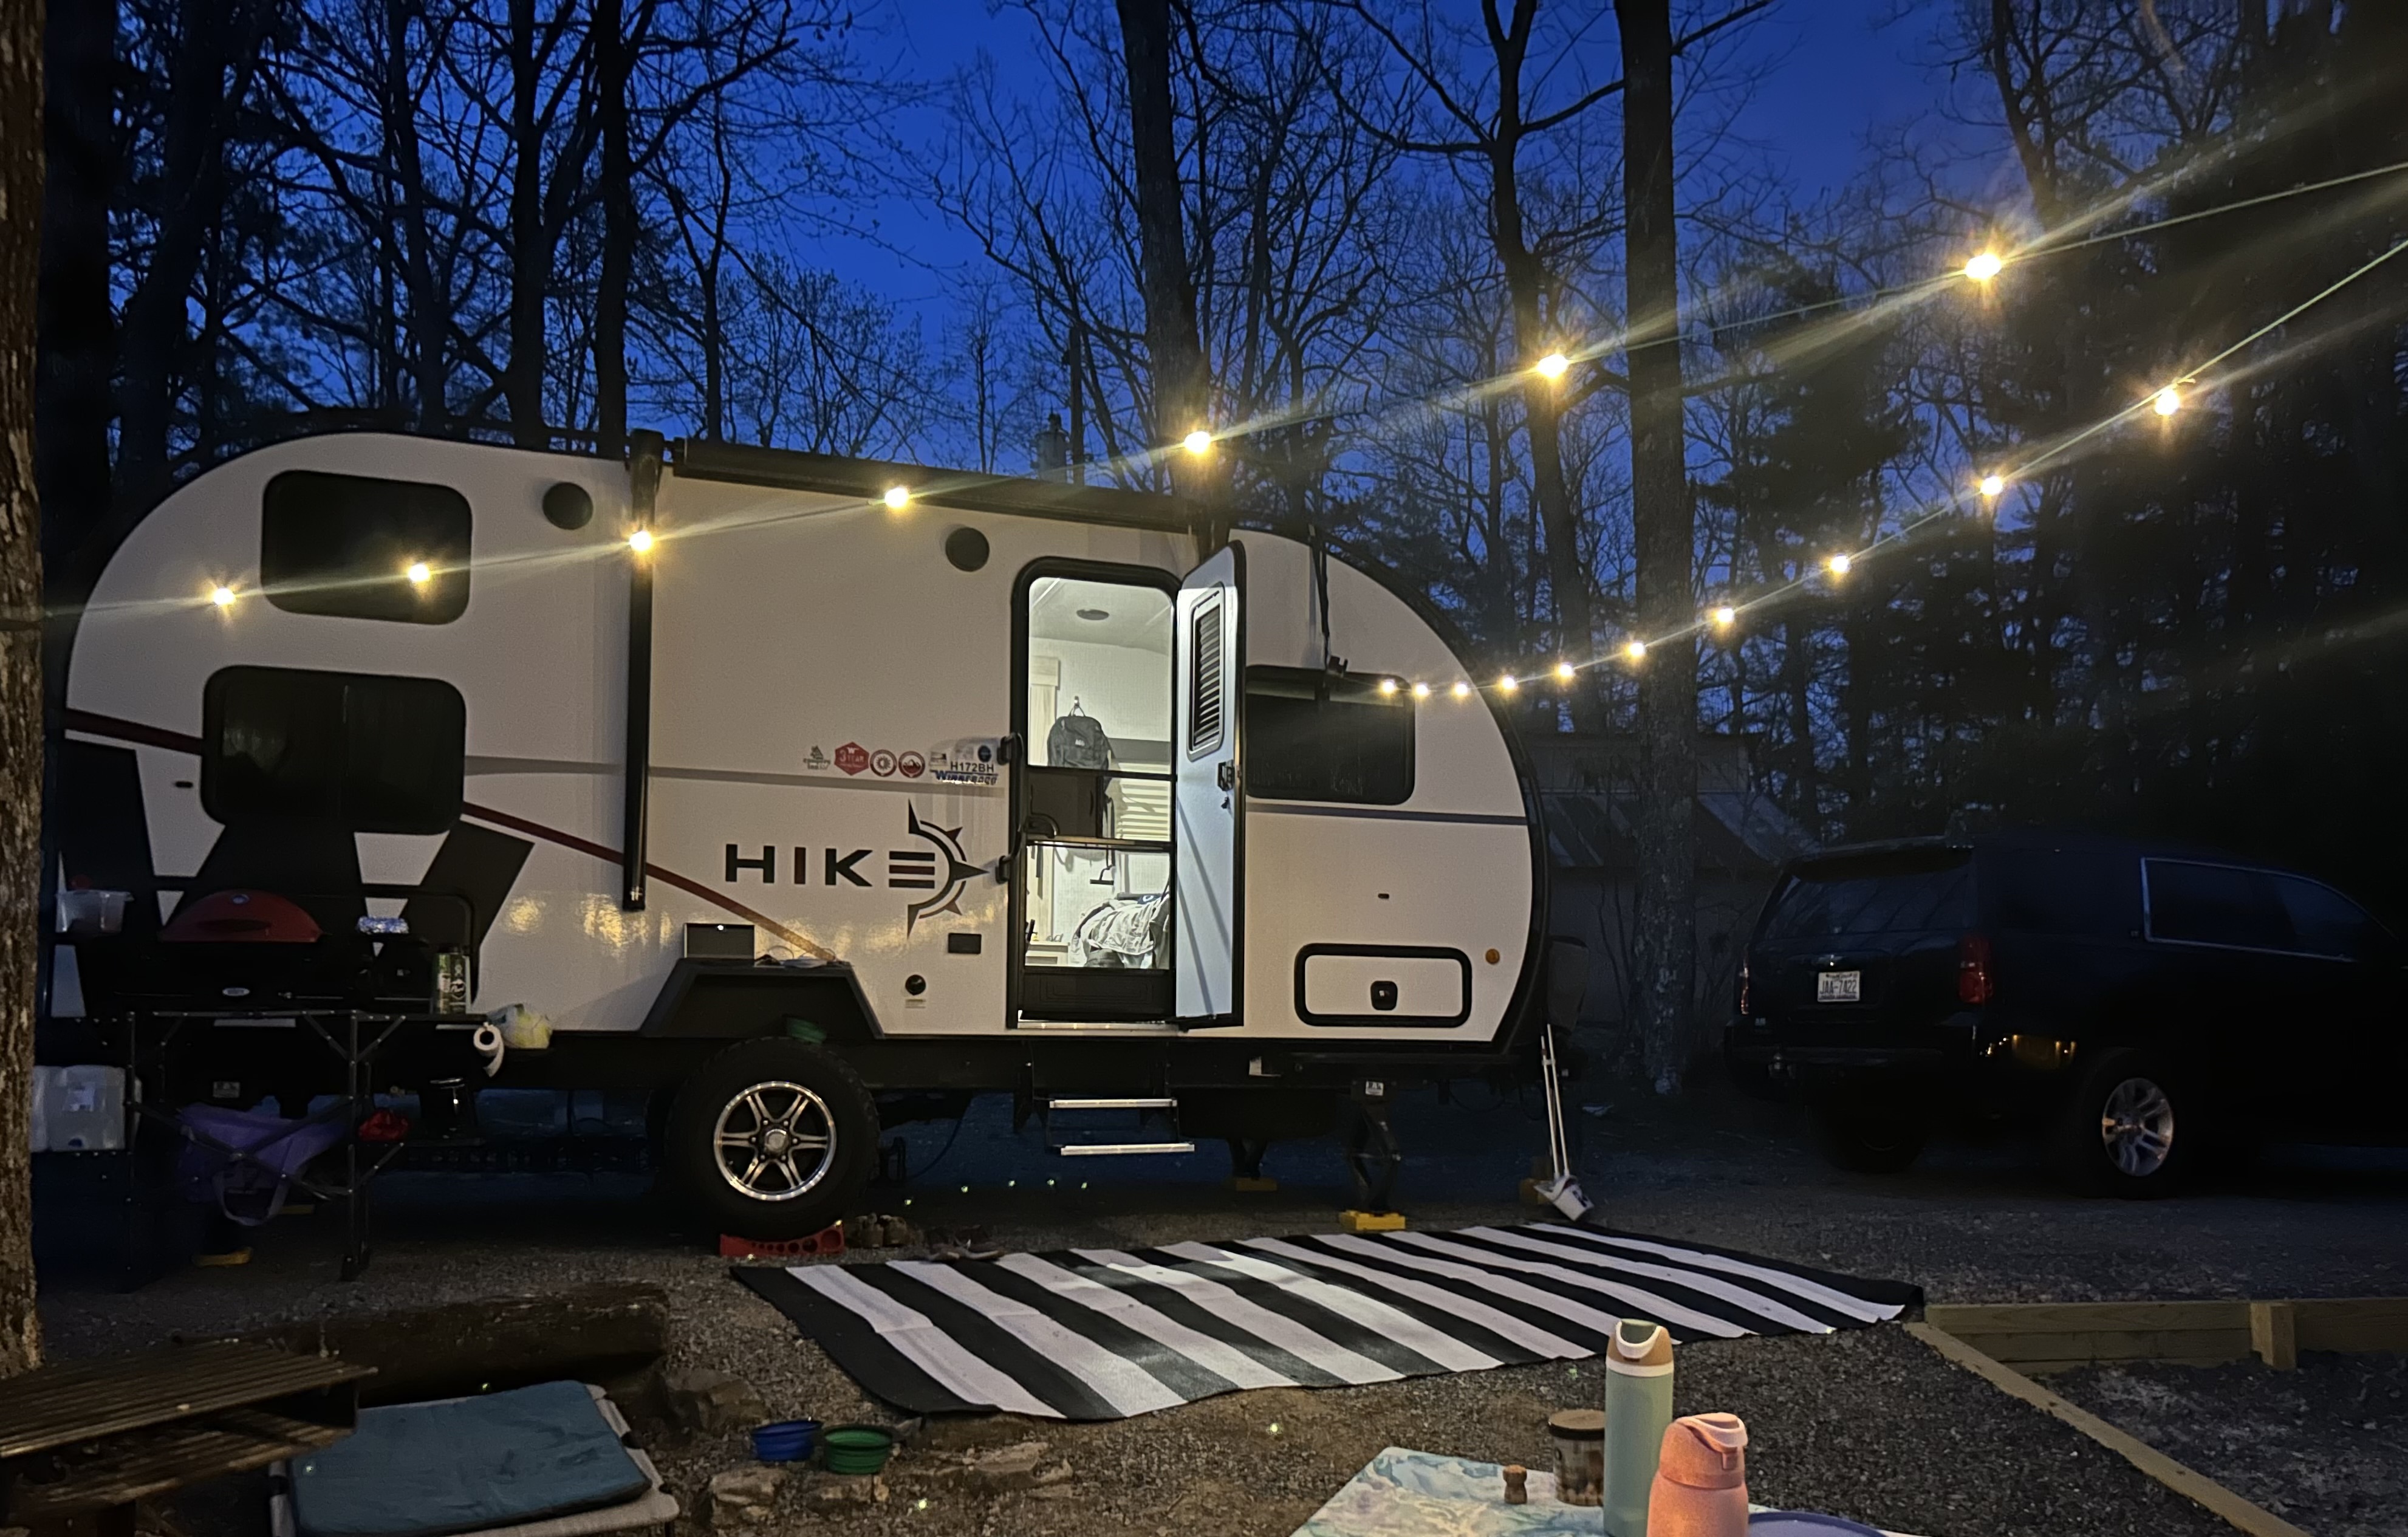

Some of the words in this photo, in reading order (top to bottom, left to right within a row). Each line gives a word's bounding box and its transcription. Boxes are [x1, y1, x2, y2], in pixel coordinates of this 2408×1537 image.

[840, 750, 846, 762] 3
[950, 761, 994, 773] H172BH
[725, 844, 935, 889] HIKE
